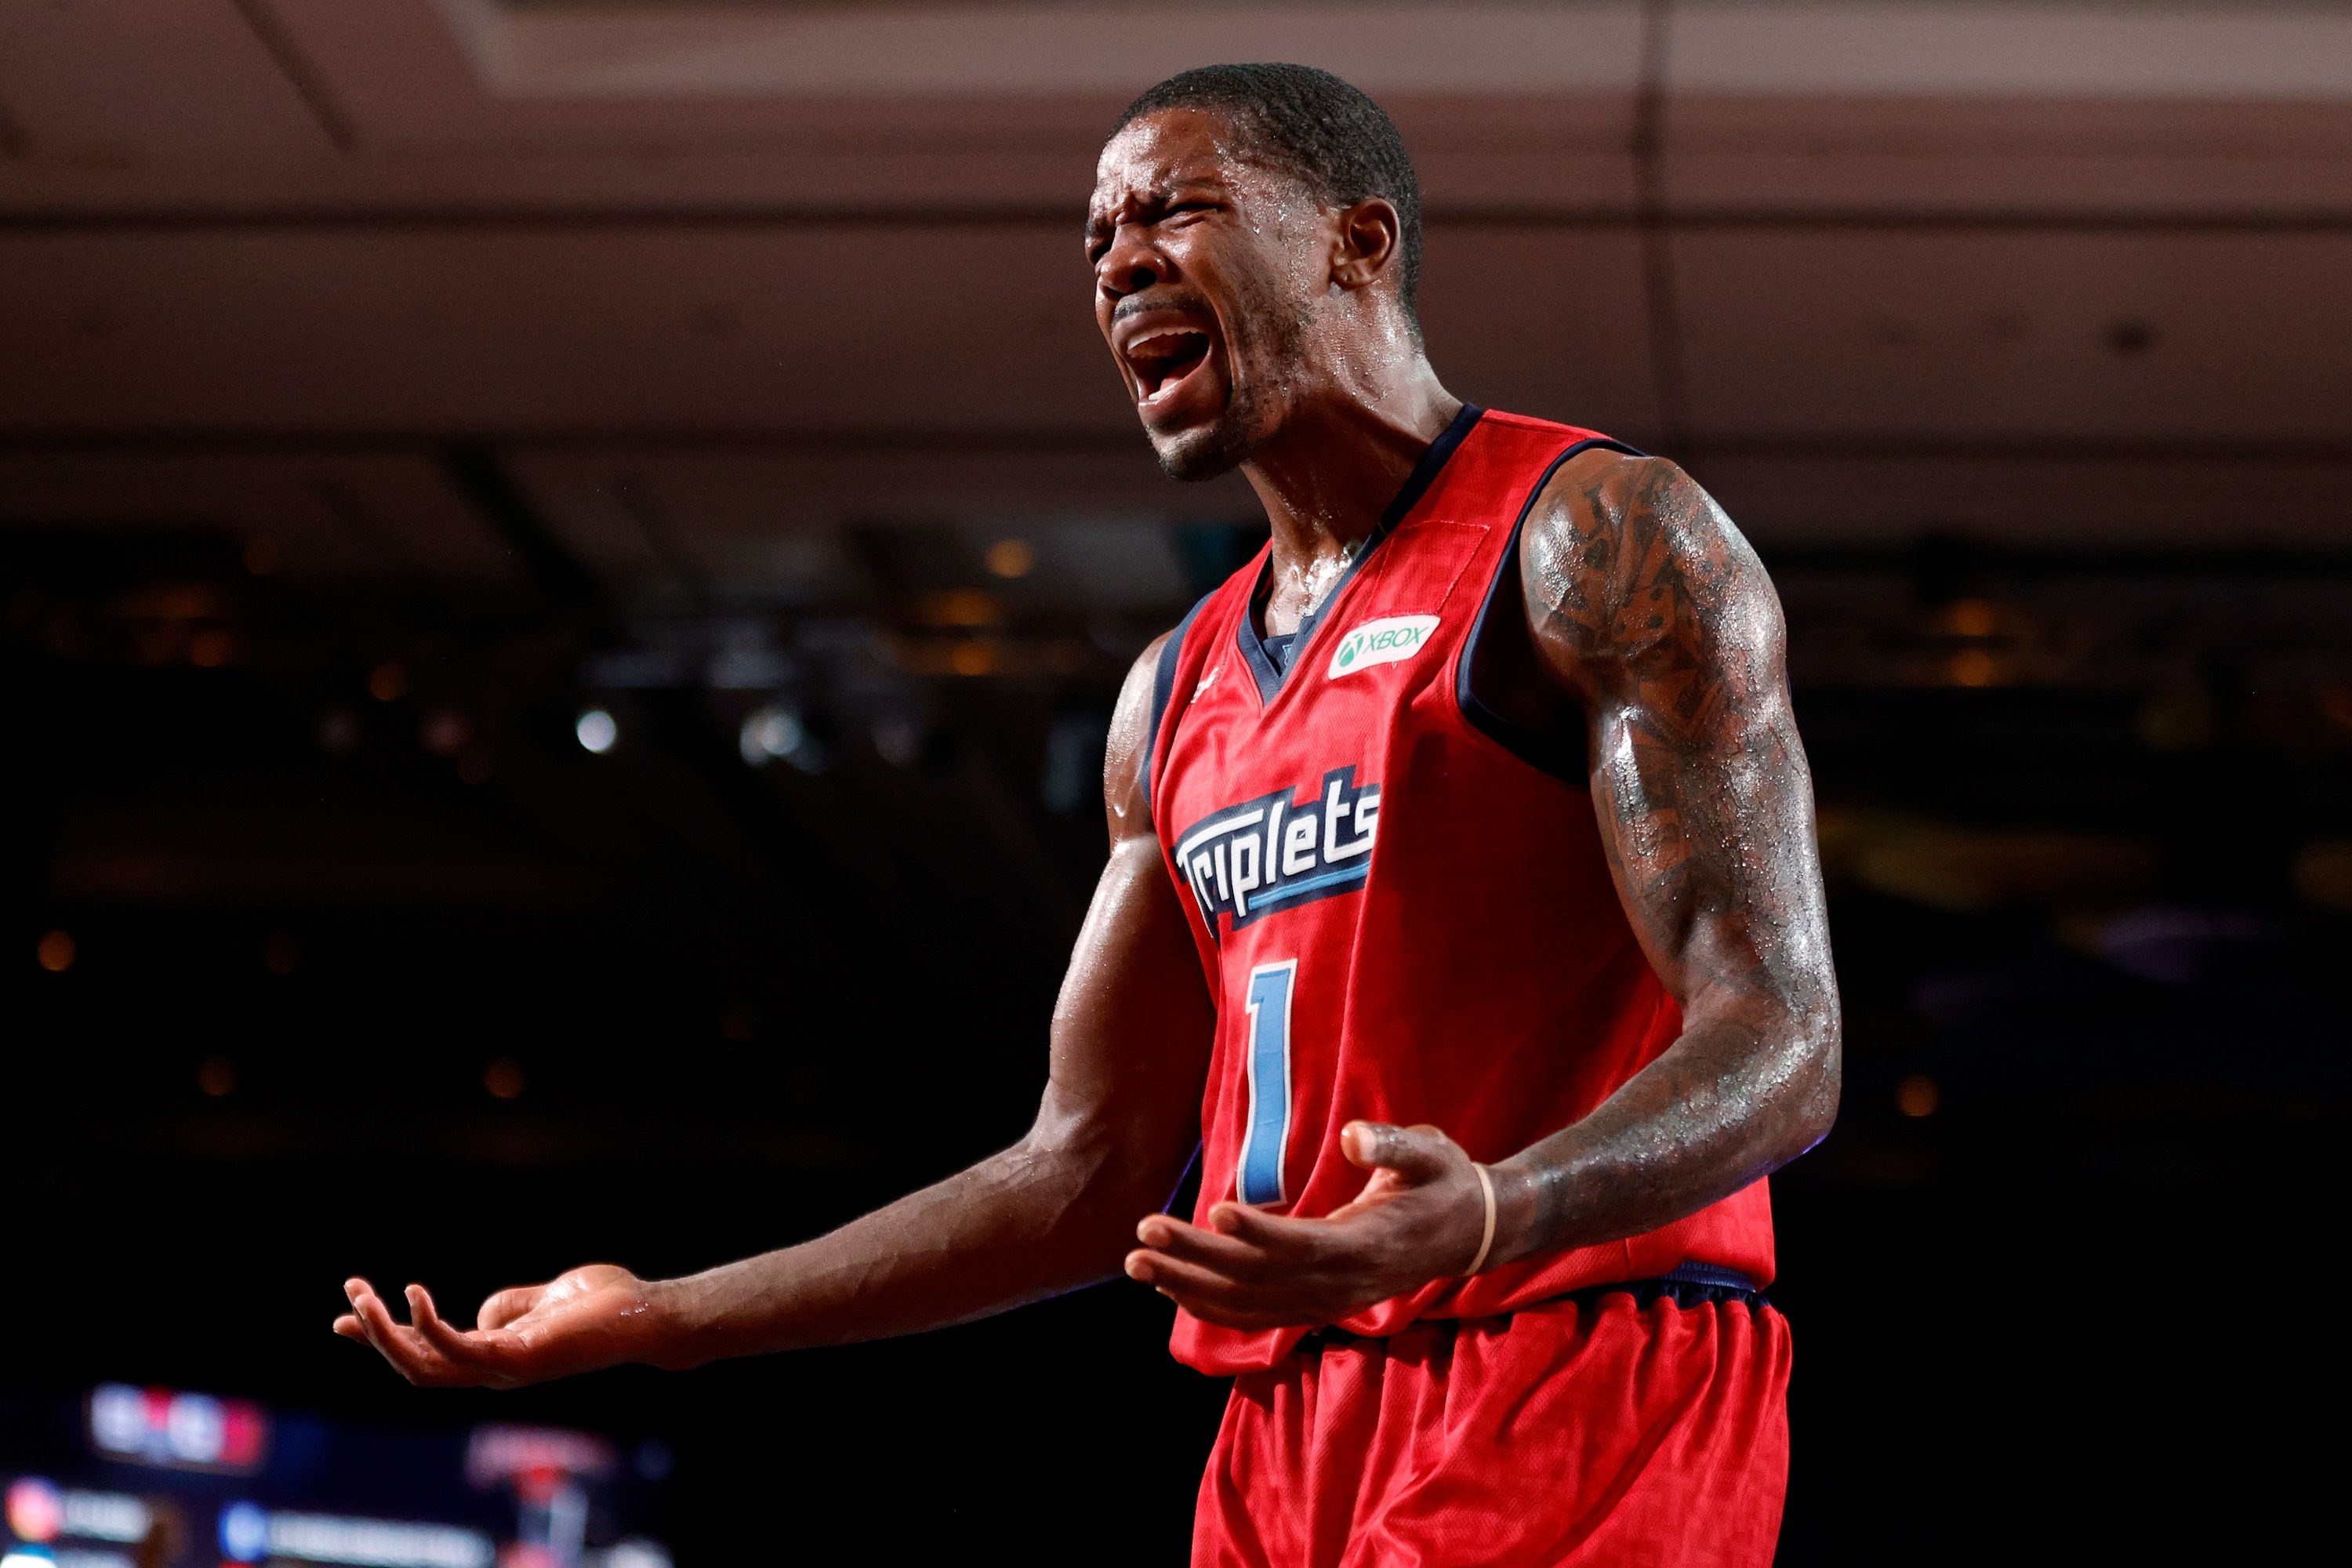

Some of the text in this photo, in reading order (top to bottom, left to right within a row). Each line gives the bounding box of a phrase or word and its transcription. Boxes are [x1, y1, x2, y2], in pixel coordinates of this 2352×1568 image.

[1363, 626, 1429, 655] XBOX
[1176, 779, 1381, 939] Triplets
[1236, 958, 1298, 1208] 1
